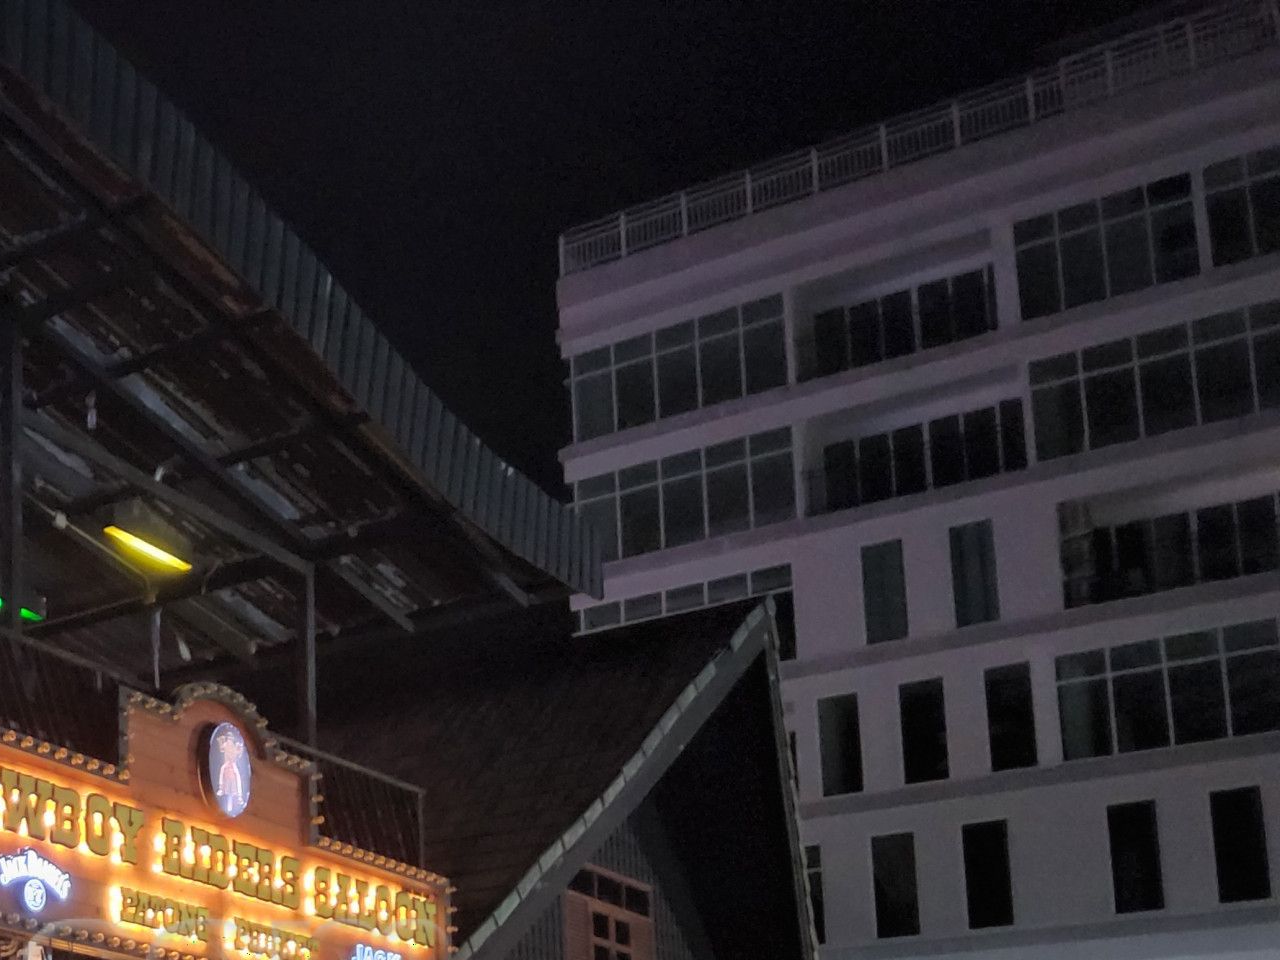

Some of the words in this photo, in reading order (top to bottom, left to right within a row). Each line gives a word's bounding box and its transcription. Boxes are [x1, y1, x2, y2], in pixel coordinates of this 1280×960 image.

[120, 886, 209, 942] PATONG
[161, 816, 300, 911] RIDERS
[314, 866, 438, 948] SALOON
